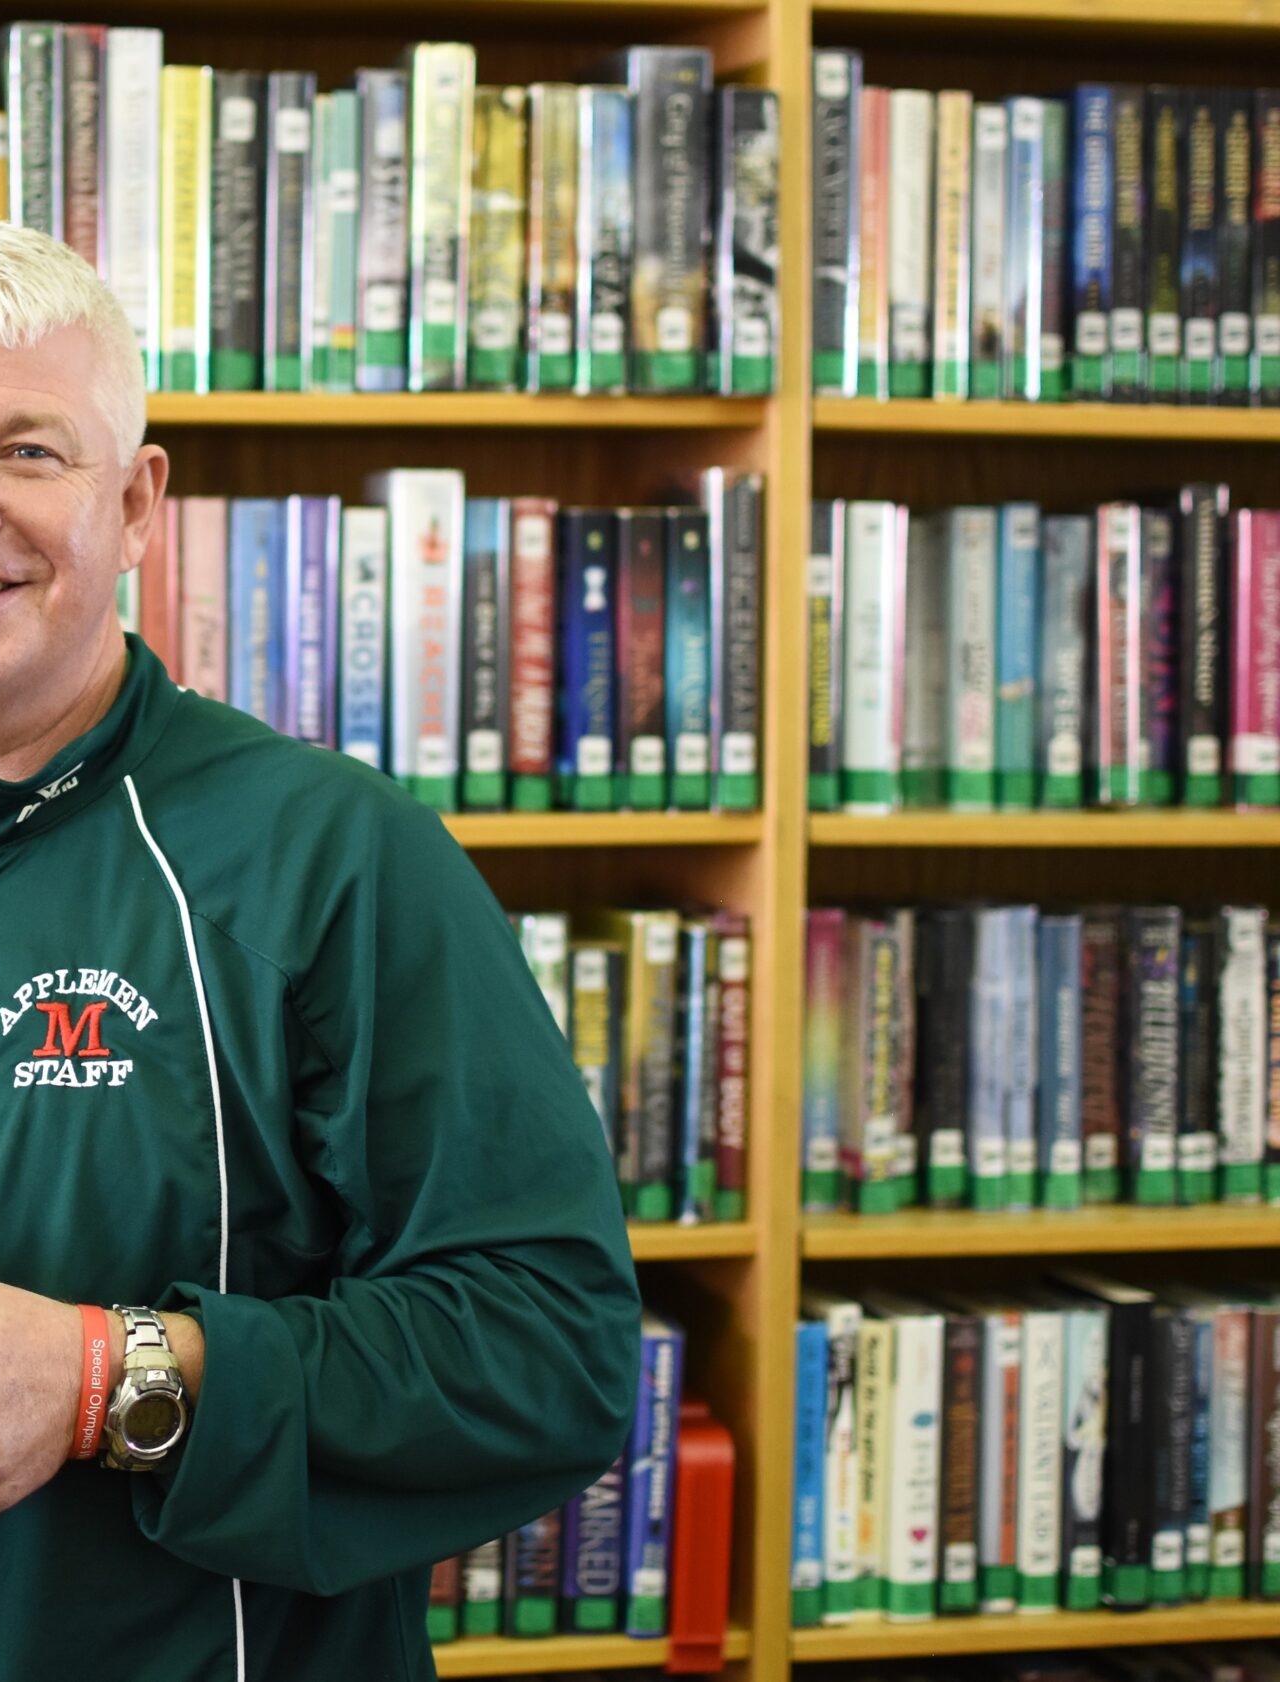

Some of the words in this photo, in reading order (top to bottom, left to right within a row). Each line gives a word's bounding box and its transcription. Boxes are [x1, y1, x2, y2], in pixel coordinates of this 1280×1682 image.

[0, 968, 159, 1036] APPLEMEN
[32, 1001, 110, 1057] M
[13, 1059, 133, 1088] STAFF
[90, 1338, 105, 1389] Special
[81, 1394, 102, 1449] Olympics
